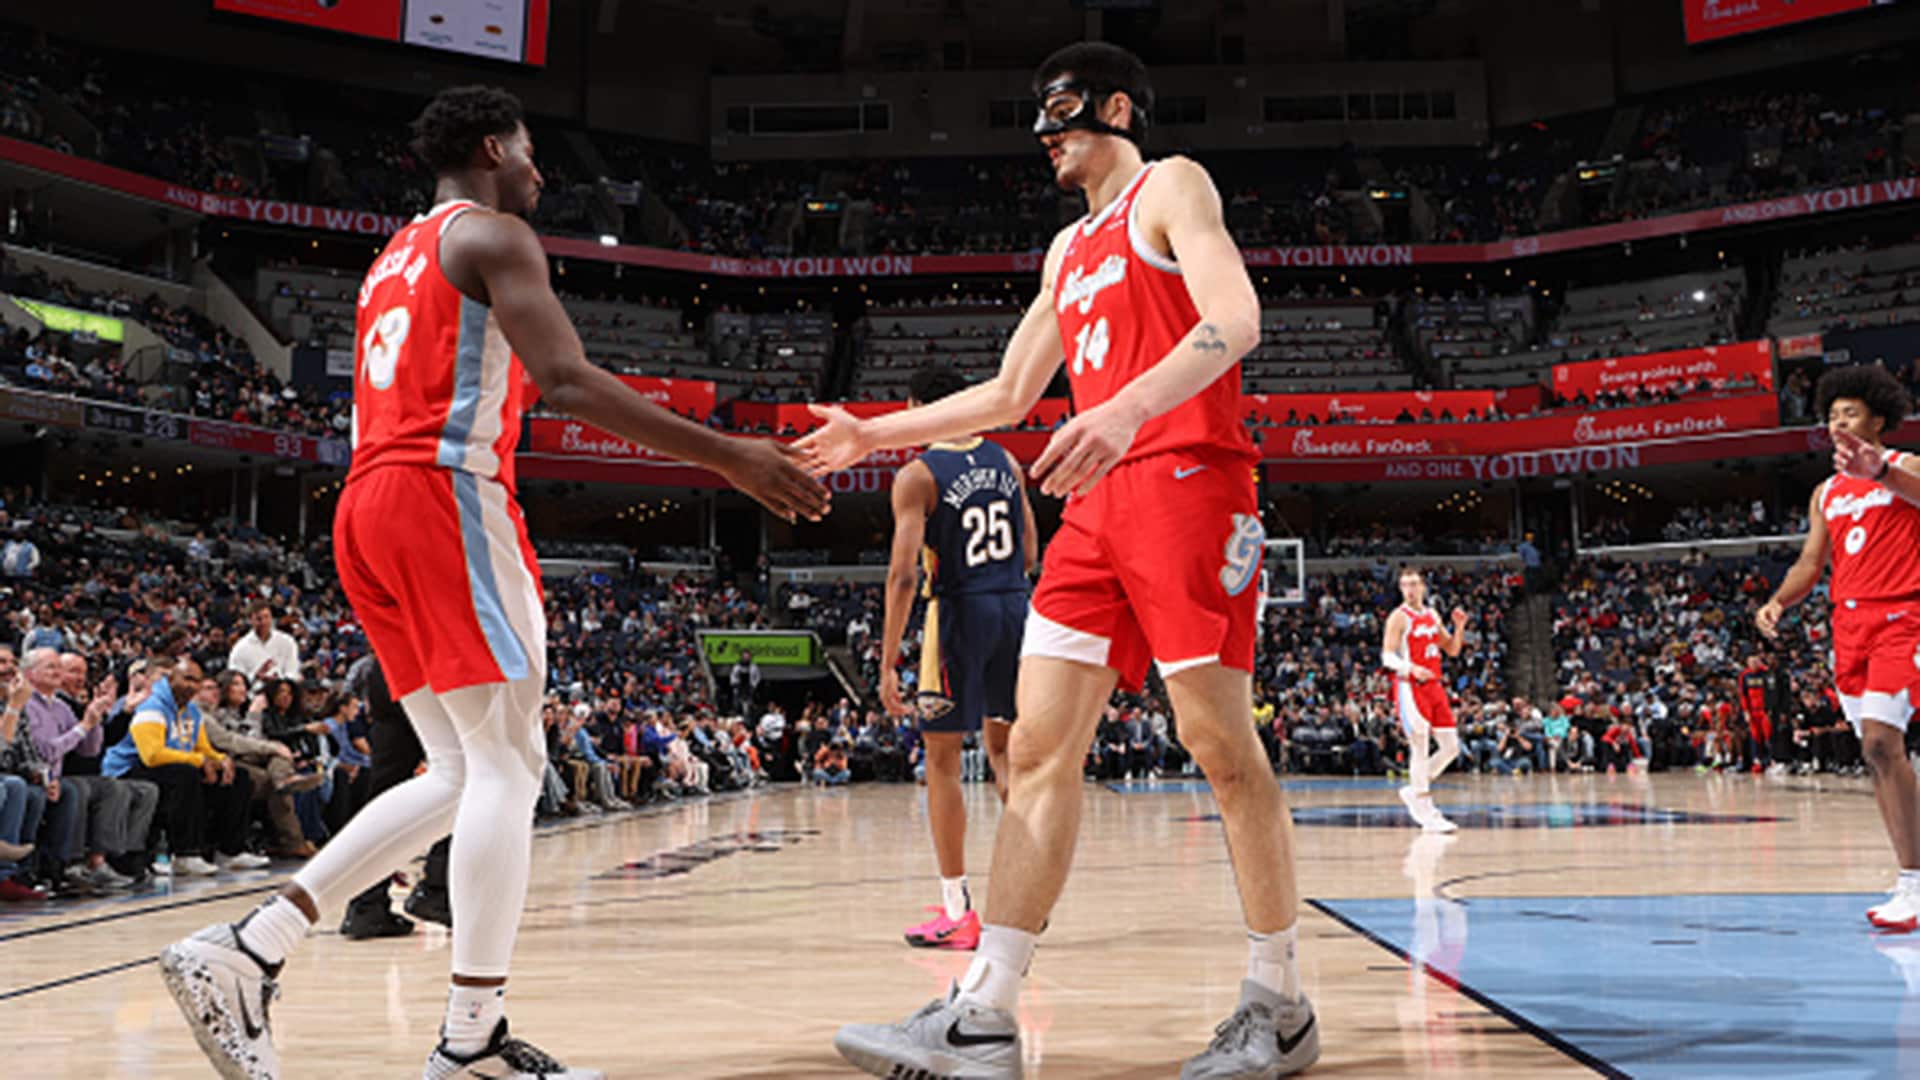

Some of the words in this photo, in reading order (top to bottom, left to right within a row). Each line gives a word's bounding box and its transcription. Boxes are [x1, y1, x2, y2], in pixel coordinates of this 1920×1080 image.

[1803, 183, 1874, 214] YOU
[244, 199, 313, 228] YOU
[322, 206, 404, 238] WON
[776, 256, 835, 277] YOU
[842, 254, 914, 277] WON
[1276, 246, 1334, 267] YOU
[1342, 245, 1414, 267] WON
[1072, 316, 1110, 377] 14
[1653, 415, 1727, 436] FanDeck
[1365, 439, 1433, 454] FanDeck
[1385, 463, 1422, 478] AND
[1425, 461, 1464, 477] ONE
[1470, 455, 1541, 480] YOU
[1551, 446, 1640, 474] WON
[821, 468, 880, 493] OU
[962, 500, 1014, 568] 25
[1844, 525, 1868, 556] 0
